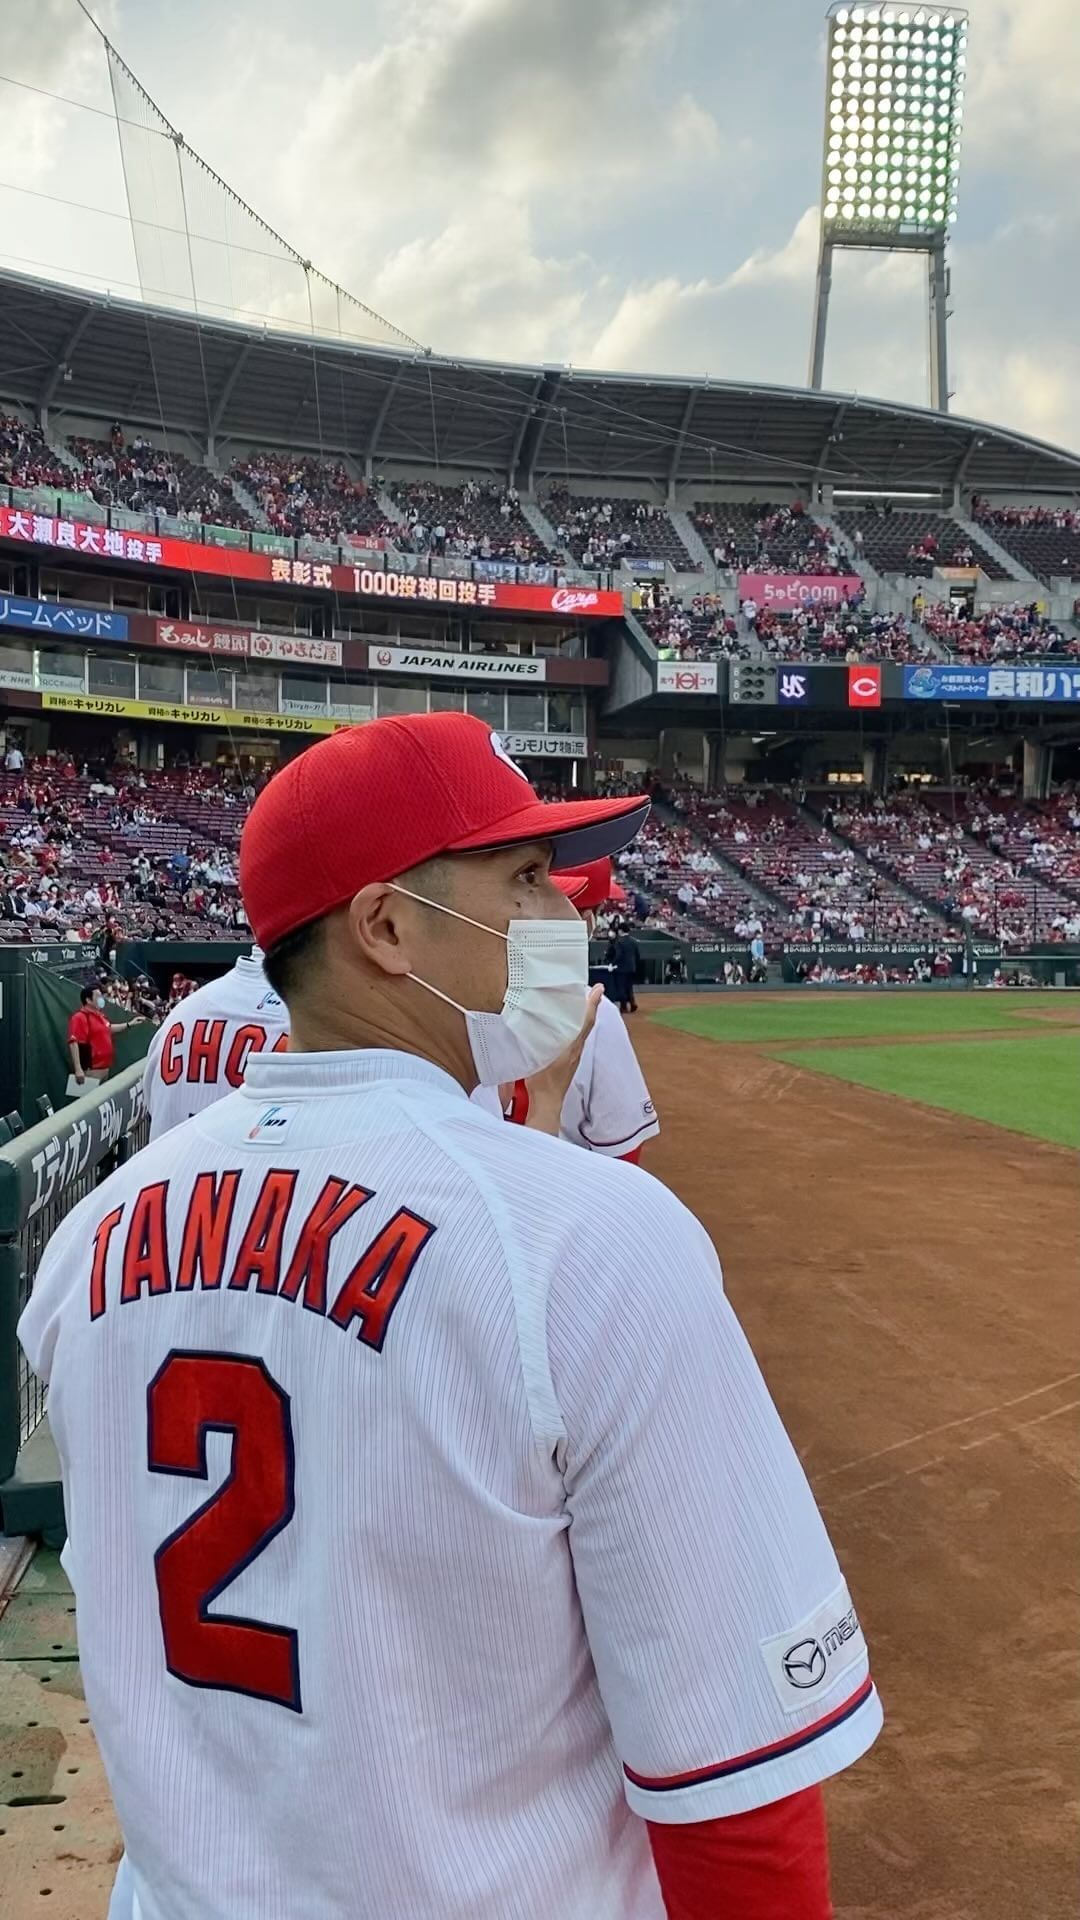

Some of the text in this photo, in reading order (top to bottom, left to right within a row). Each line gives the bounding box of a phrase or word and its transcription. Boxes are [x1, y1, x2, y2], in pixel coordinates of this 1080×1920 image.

[8, 511, 163, 563] 大瀬良大地投手
[271, 558, 333, 590] 表彰式
[353, 568, 497, 605] 1000投球回投手
[551, 589, 599, 613] Carp
[399, 655, 539, 674] JAPAN AIRLINES
[987, 670, 1080, 697] 良和ハ
[49, 696, 125, 713] 資格のキャリカレ
[515, 738, 585, 755] シモハナ物流
[161, 1019, 288, 1088] CHO
[89, 1168, 437, 1354] TANAKA
[146, 1348, 303, 1714] 2
